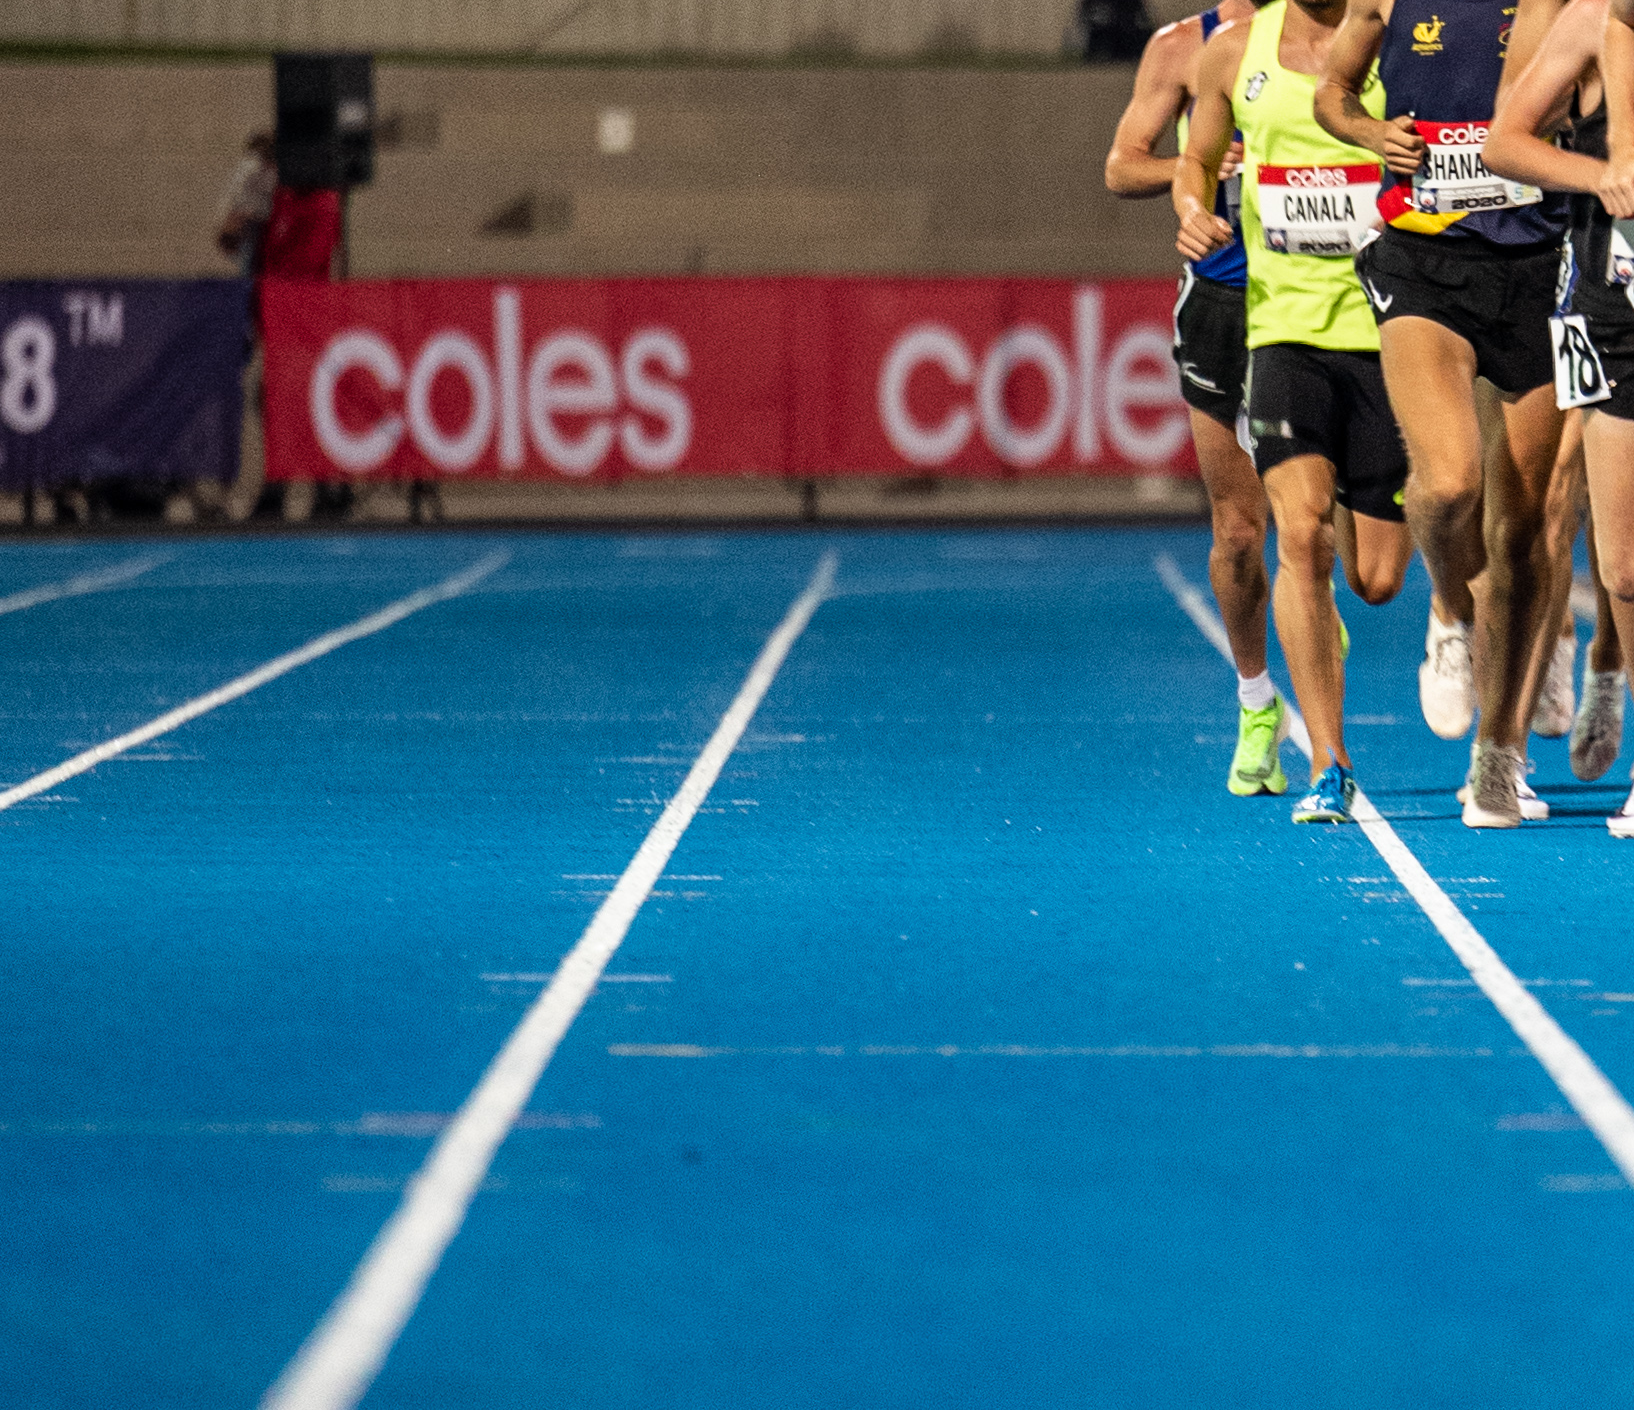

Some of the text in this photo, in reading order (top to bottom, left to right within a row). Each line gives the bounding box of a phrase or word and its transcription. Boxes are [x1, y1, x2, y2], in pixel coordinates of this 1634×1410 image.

[1439, 123, 1489, 144] cole
[1423, 153, 1491, 180] SHANA
[1284, 193, 1356, 222] CANALA
[1452, 195, 1507, 210] 2020
[311, 289, 690, 473] coles
[878, 285, 1192, 466] cole
